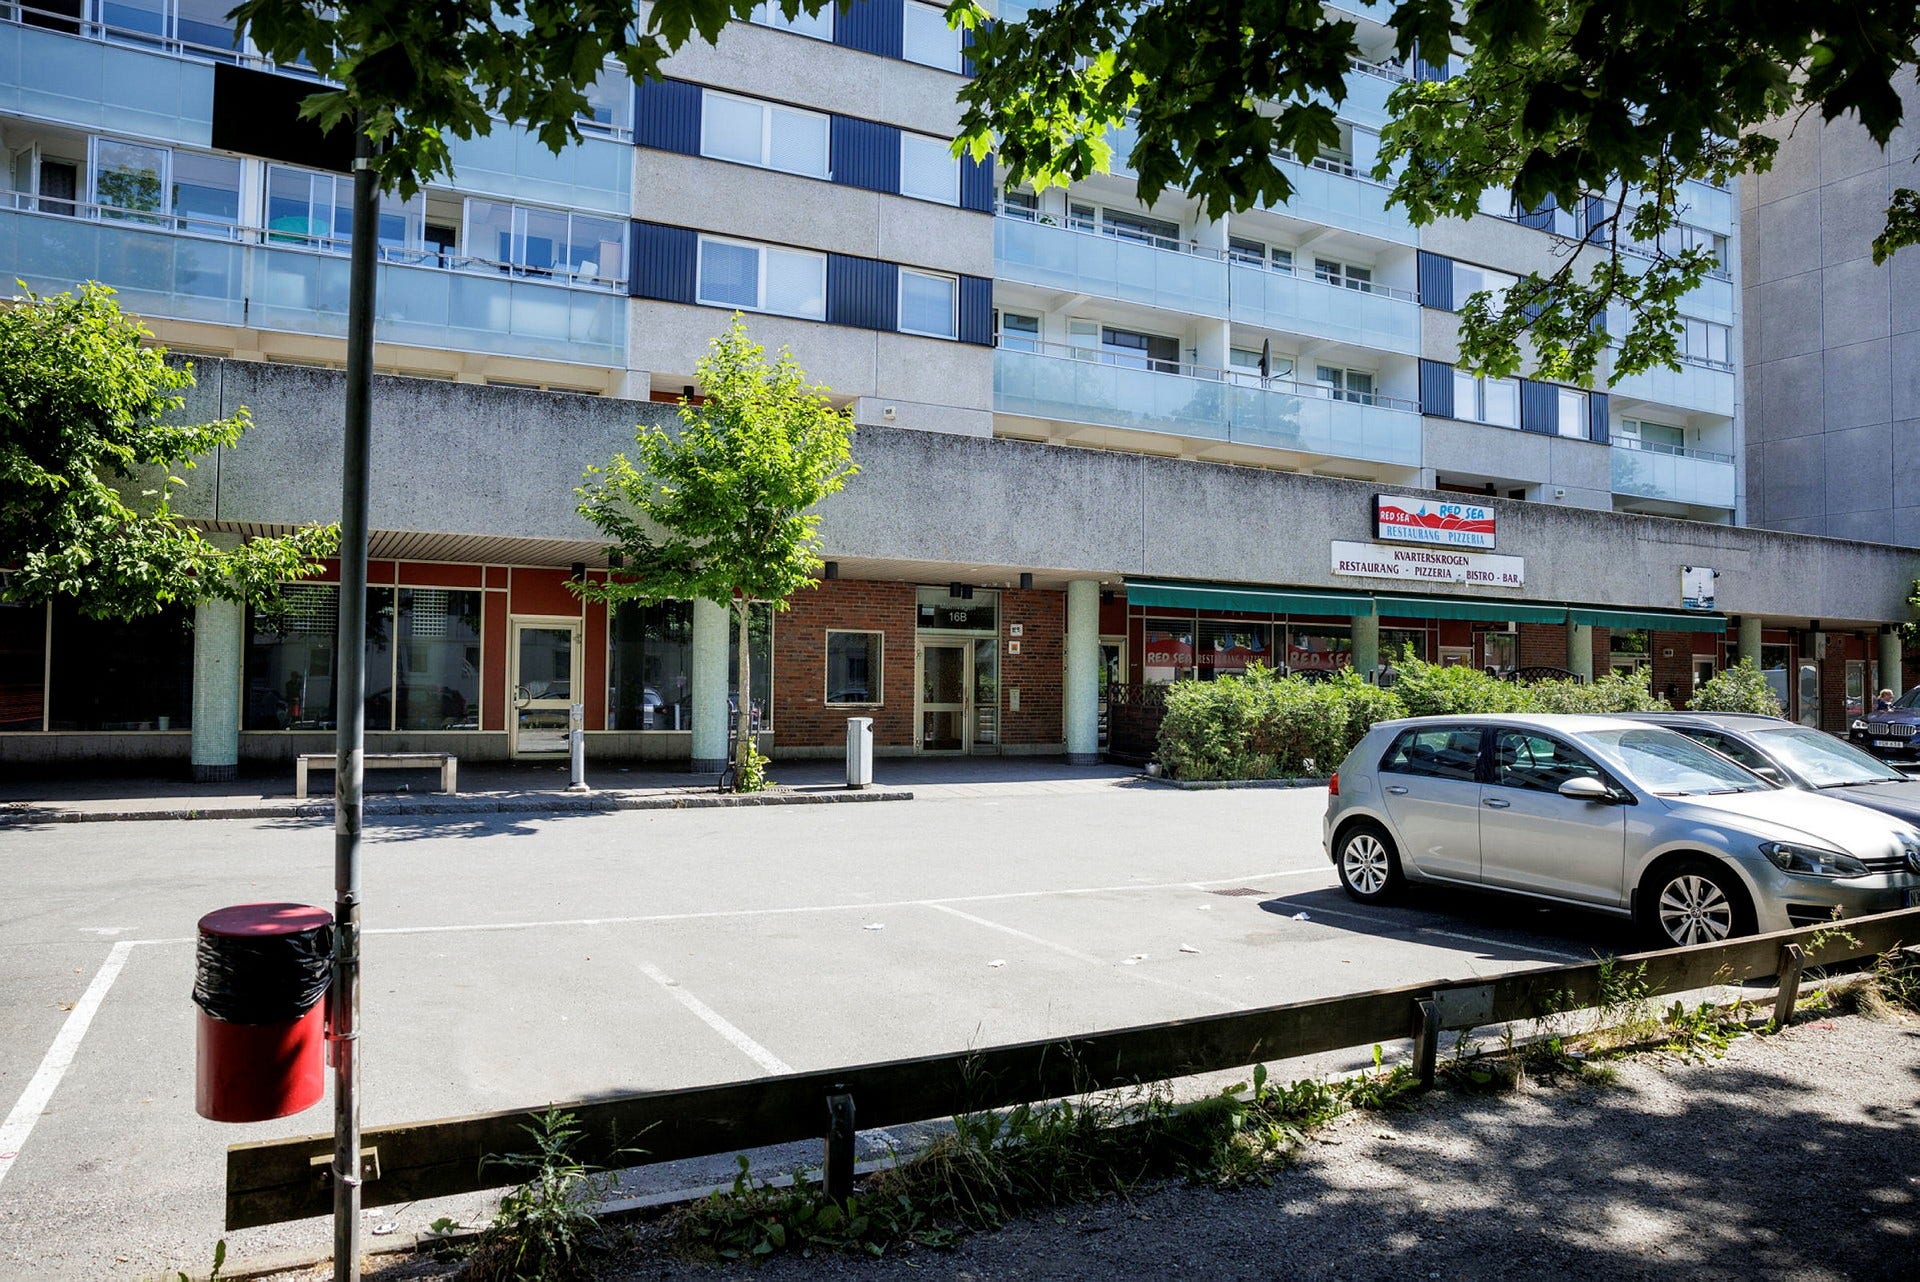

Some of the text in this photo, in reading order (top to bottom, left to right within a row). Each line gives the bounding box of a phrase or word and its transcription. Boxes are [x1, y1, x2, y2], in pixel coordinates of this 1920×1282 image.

[1380, 511, 1409, 522] RED SEA
[1440, 505, 1485, 519] RED SEA
[1387, 526, 1485, 545] RESTAURANG PIZZERIA
[1394, 551, 1469, 566] KVARTERSKROGEN
[1339, 561, 1399, 574] RESTAURANG
[1415, 567, 1452, 578] PIZZERIA
[1466, 570, 1495, 581] BISTRO
[1502, 573, 1519, 583] BAR
[950, 612, 967, 622] 16B
[1147, 652, 1193, 665] RED SEA
[1290, 651, 1320, 667] RED
